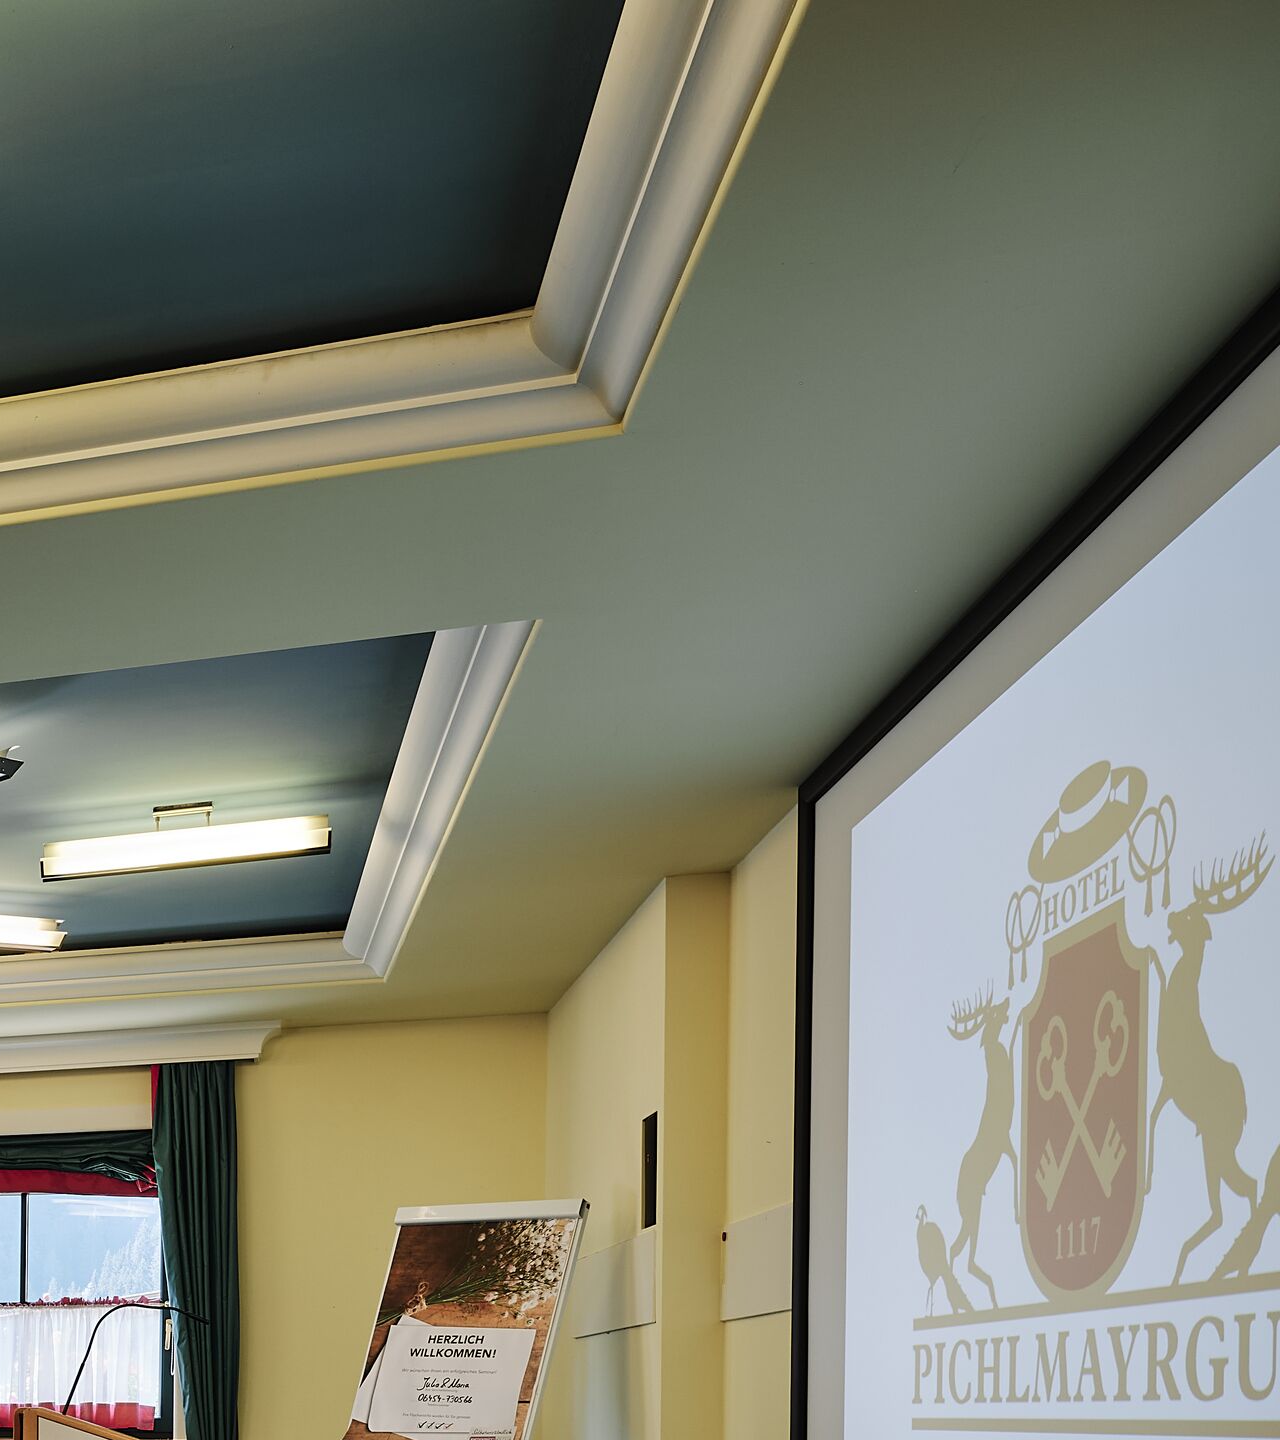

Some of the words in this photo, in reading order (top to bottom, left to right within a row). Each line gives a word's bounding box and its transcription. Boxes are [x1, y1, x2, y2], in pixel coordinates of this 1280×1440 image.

[1043, 855, 1125, 936] HOTEL
[1055, 1215, 1101, 1260] 1117
[409, 1348, 497, 1359] WILLKOMMEN!
[427, 1335, 485, 1345] HERZLICH
